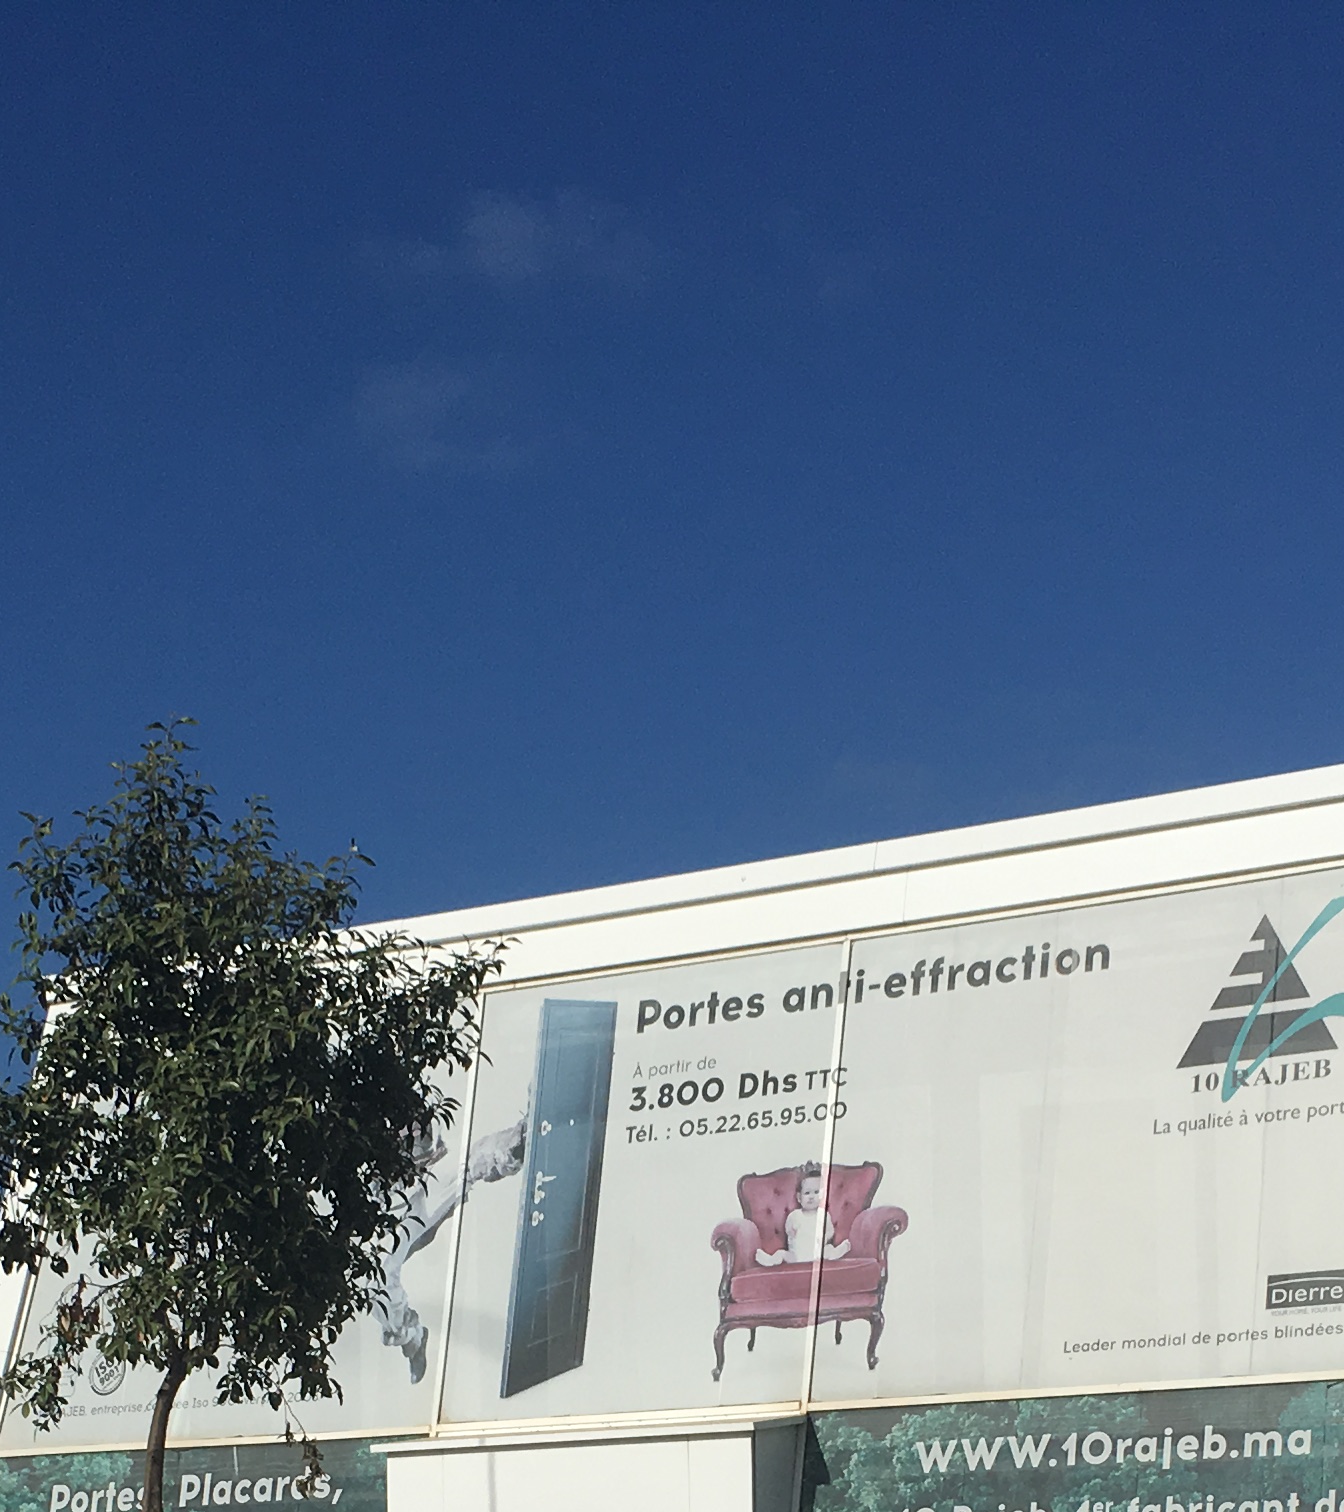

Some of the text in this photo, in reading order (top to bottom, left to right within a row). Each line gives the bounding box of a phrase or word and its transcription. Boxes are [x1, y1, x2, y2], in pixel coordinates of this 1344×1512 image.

[636, 942, 1111, 1034] Portes anti-effraction
[648, 1059, 692, 1080] partir
[696, 1056, 717, 1071] de
[1190, 1058, 1332, 1093] 10 RAJEB
[629, 1067, 848, 1112] 3.800 Dhs TTC
[679, 1101, 847, 1138] 05.22.65.95.00
[1153, 1118, 1171, 1135] La
[1177, 1110, 1233, 1136] qualité
[1239, 1109, 1249, 1126] à
[1255, 1107, 1301, 1124] votre
[1063, 1340, 1116, 1354] Leader
[1122, 1333, 1186, 1350] mondial
[1192, 1331, 1211, 1345] de
[1216, 1328, 1268, 1346] portes
[91, 1402, 143, 1416] entreprise
